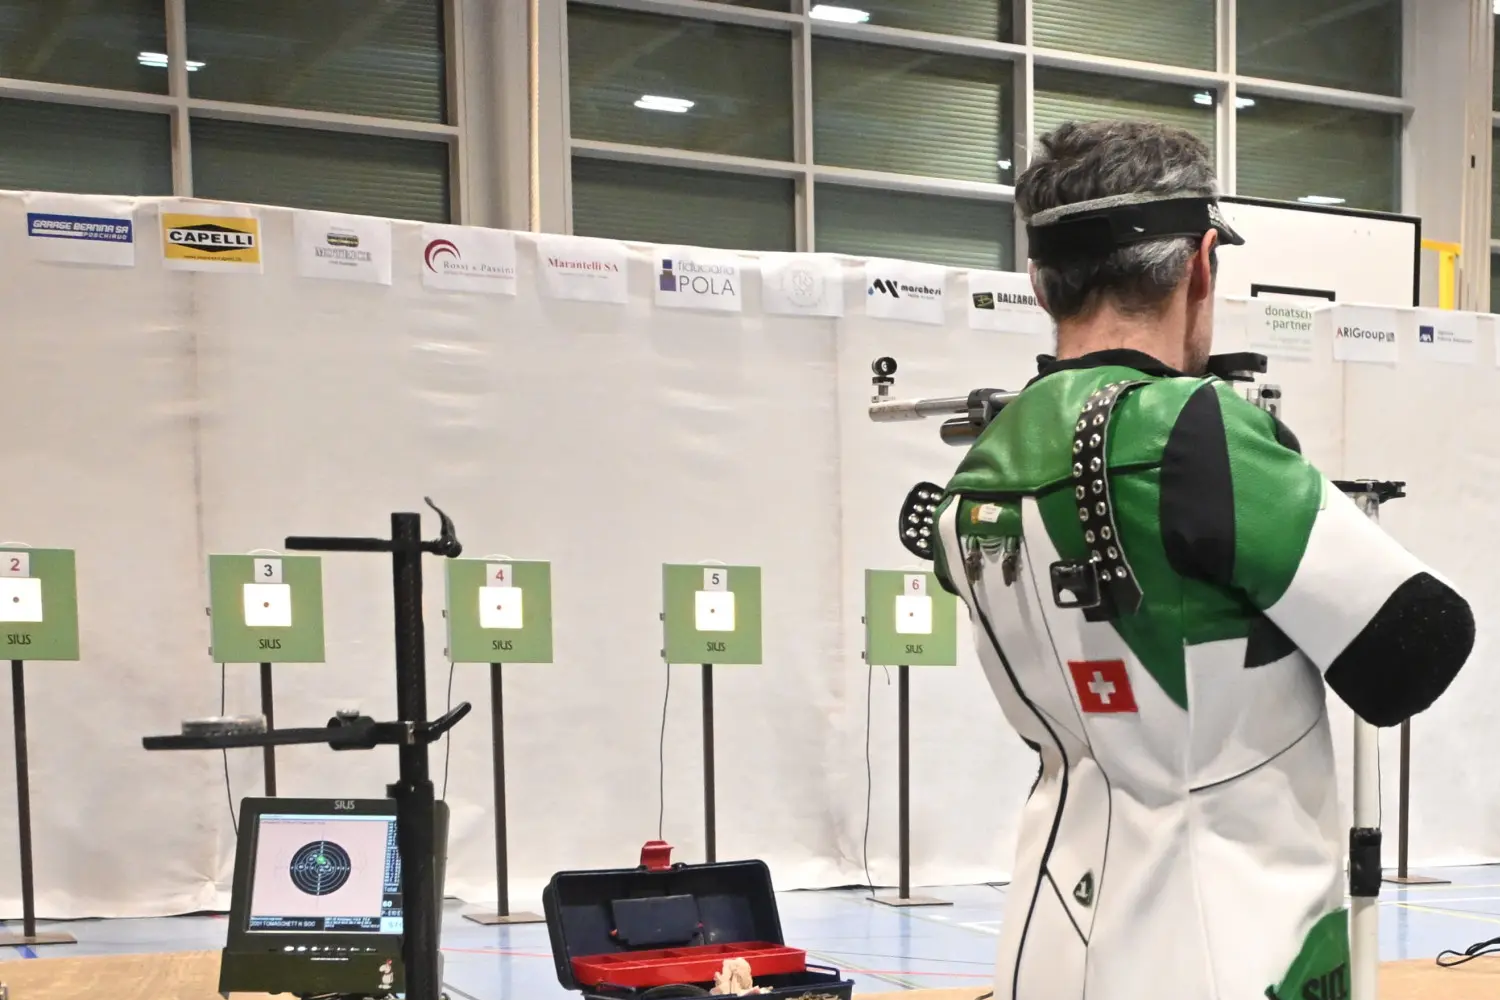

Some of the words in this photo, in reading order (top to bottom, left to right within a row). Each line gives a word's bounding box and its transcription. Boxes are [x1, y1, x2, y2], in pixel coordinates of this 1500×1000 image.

[33, 219, 73, 230] GARAGE
[73, 222, 114, 232] BERNINA
[115, 225, 129, 234] SA
[169, 230, 253, 245] CAPELLI
[548, 257, 602, 271] Marantelli
[603, 263, 619, 273] SA
[679, 274, 736, 296] POLA
[900, 283, 942, 296] marchesi
[1264, 304, 1312, 320] donatsch
[1272, 319, 1312, 332] partner
[1336, 326, 1386, 342] ARIGroup
[10, 557, 20, 571] 2
[263, 563, 273, 577] 3
[495, 568, 504, 582] 4
[711, 573, 720, 585] 5
[912, 578, 920, 590] 6
[7, 633, 32, 645] SIUS
[258, 638, 282, 649] SIUS
[492, 640, 513, 651] SIUS
[706, 641, 726, 652] SIUS
[905, 644, 924, 654] SIUS
[333, 800, 355, 810] SIUS
